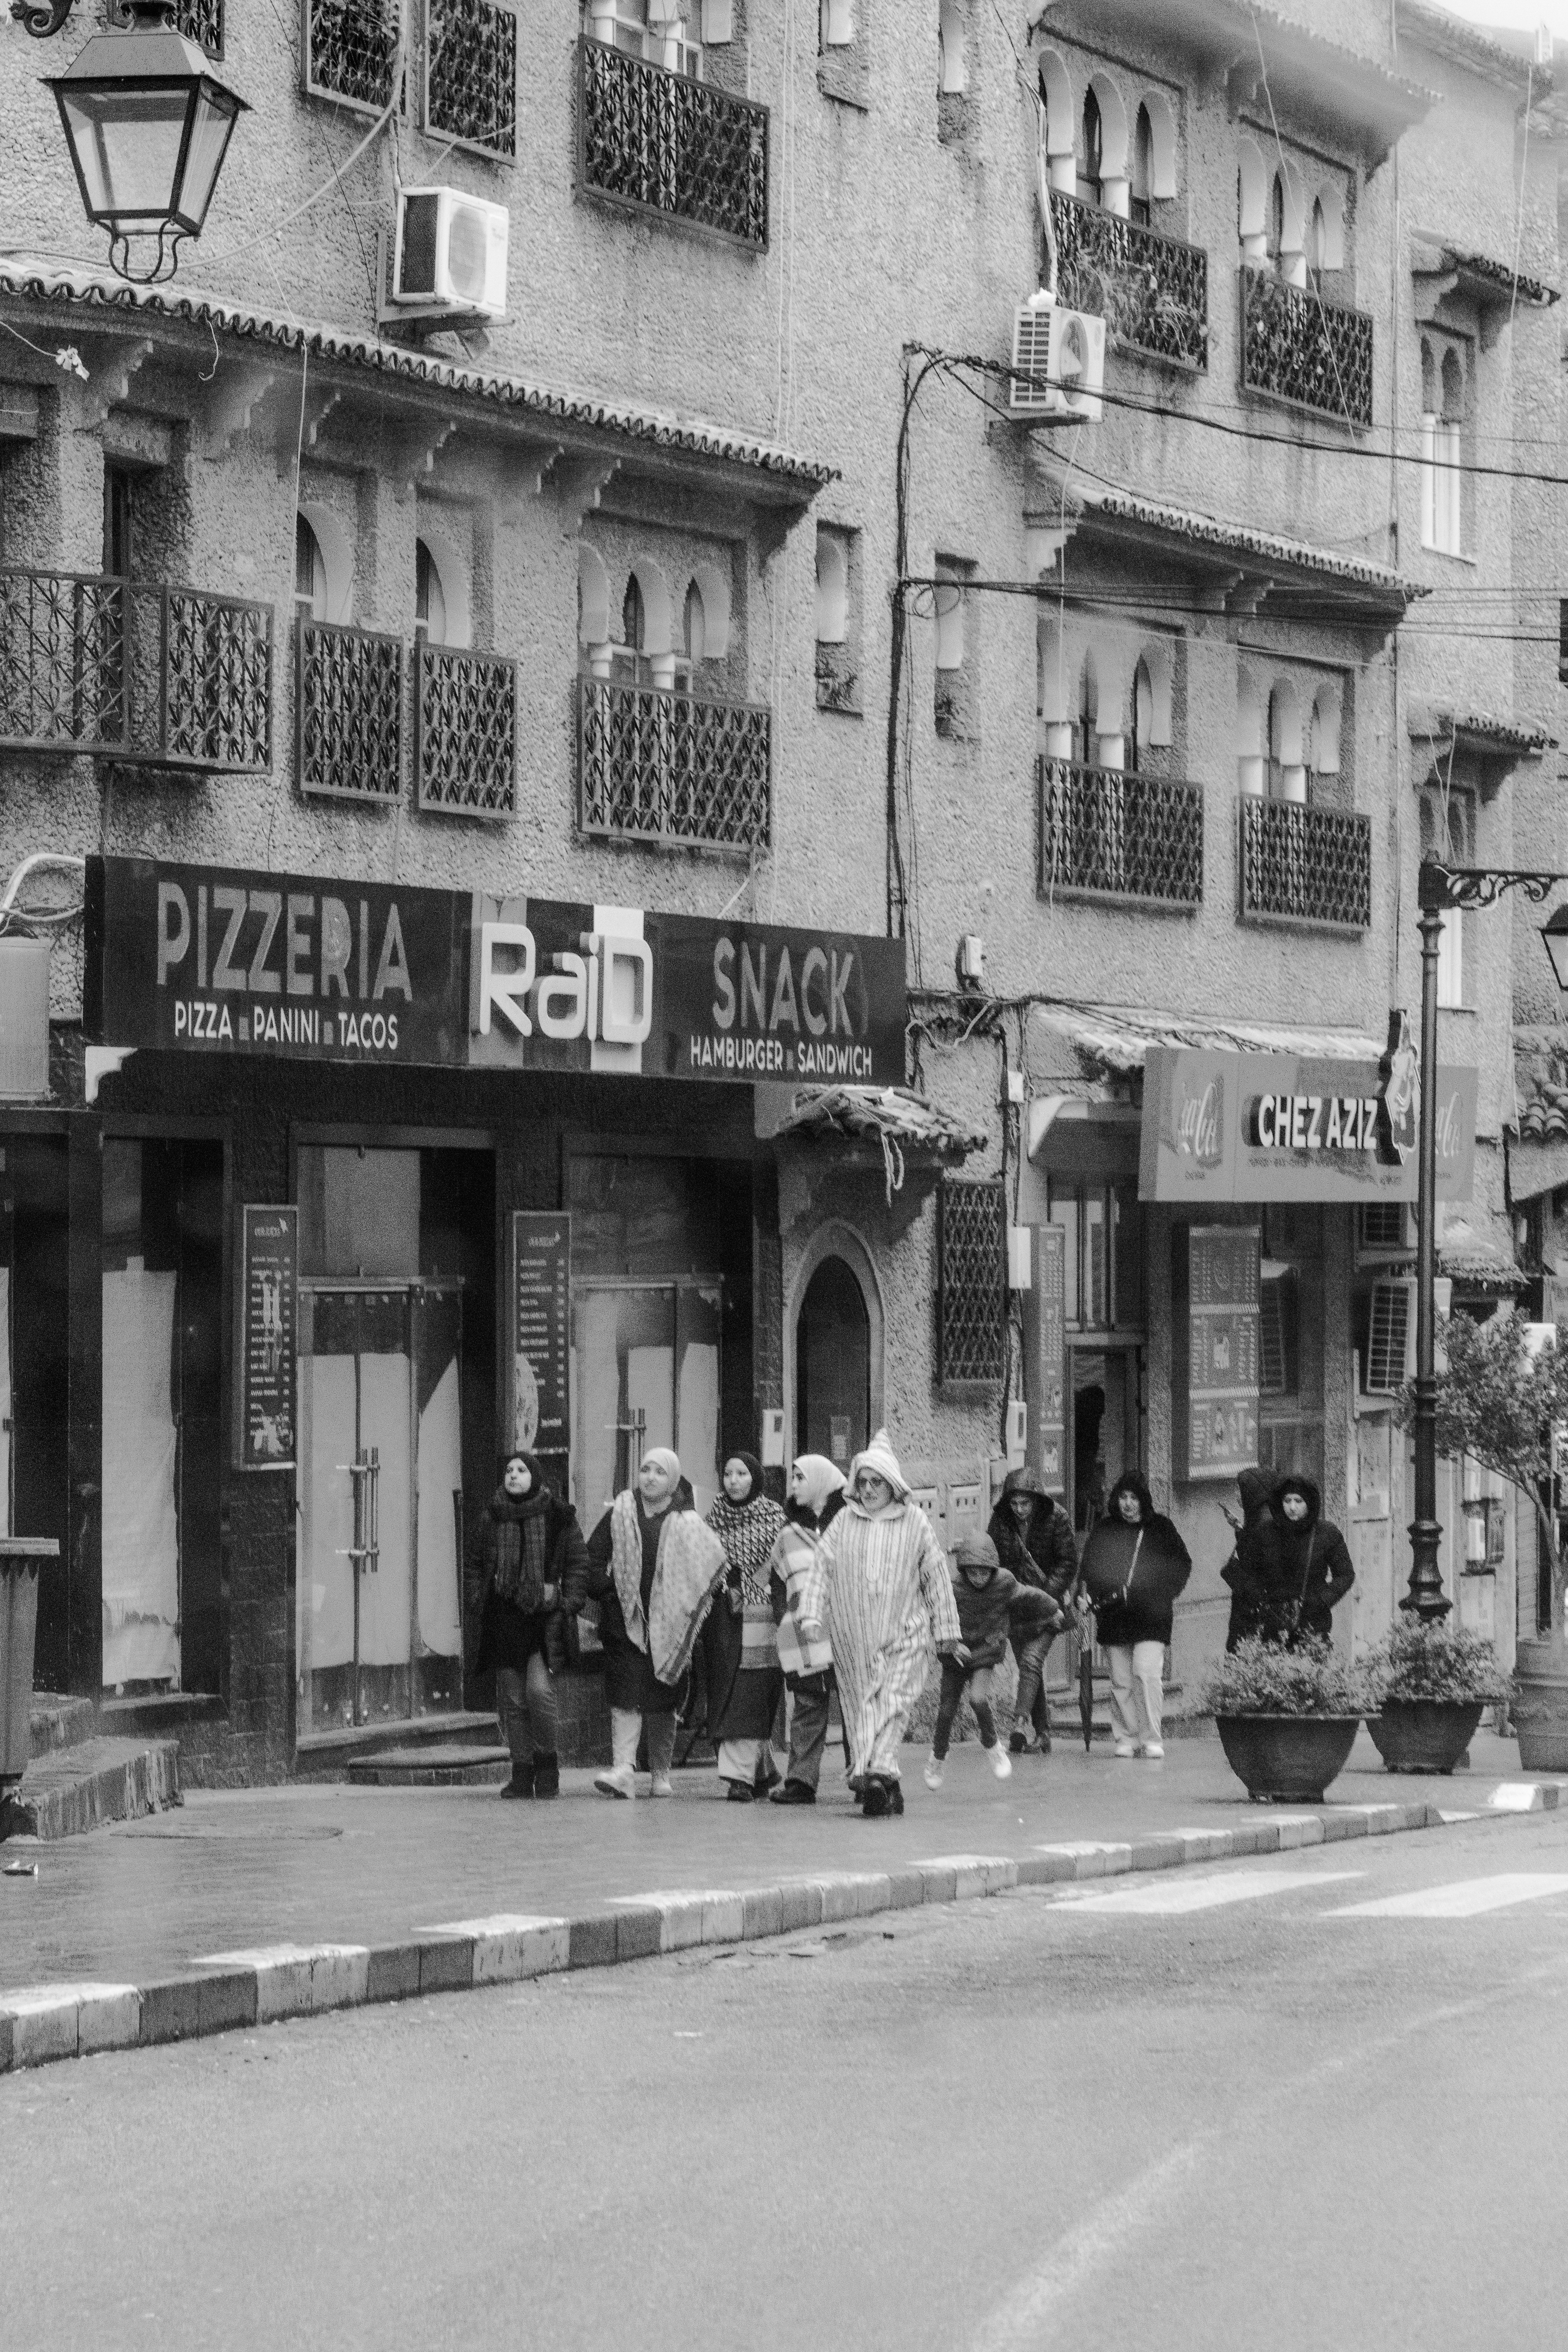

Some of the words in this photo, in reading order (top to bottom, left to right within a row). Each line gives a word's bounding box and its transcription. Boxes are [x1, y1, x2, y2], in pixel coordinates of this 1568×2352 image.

[157, 881, 413, 1001] PIZZERIA
[712, 936, 854, 1036] SNACK
[175, 1001, 233, 1039] PIZZA
[254, 1005, 319, 1044] PANINI
[338, 1011, 398, 1050] TACOS
[690, 1035, 783, 1071] HAMBURGER
[797, 1042, 872, 1076] SANDWICH
[1258, 1094, 1322, 1149] CHEZ
[1326, 1097, 1378, 1150] AZIZ
